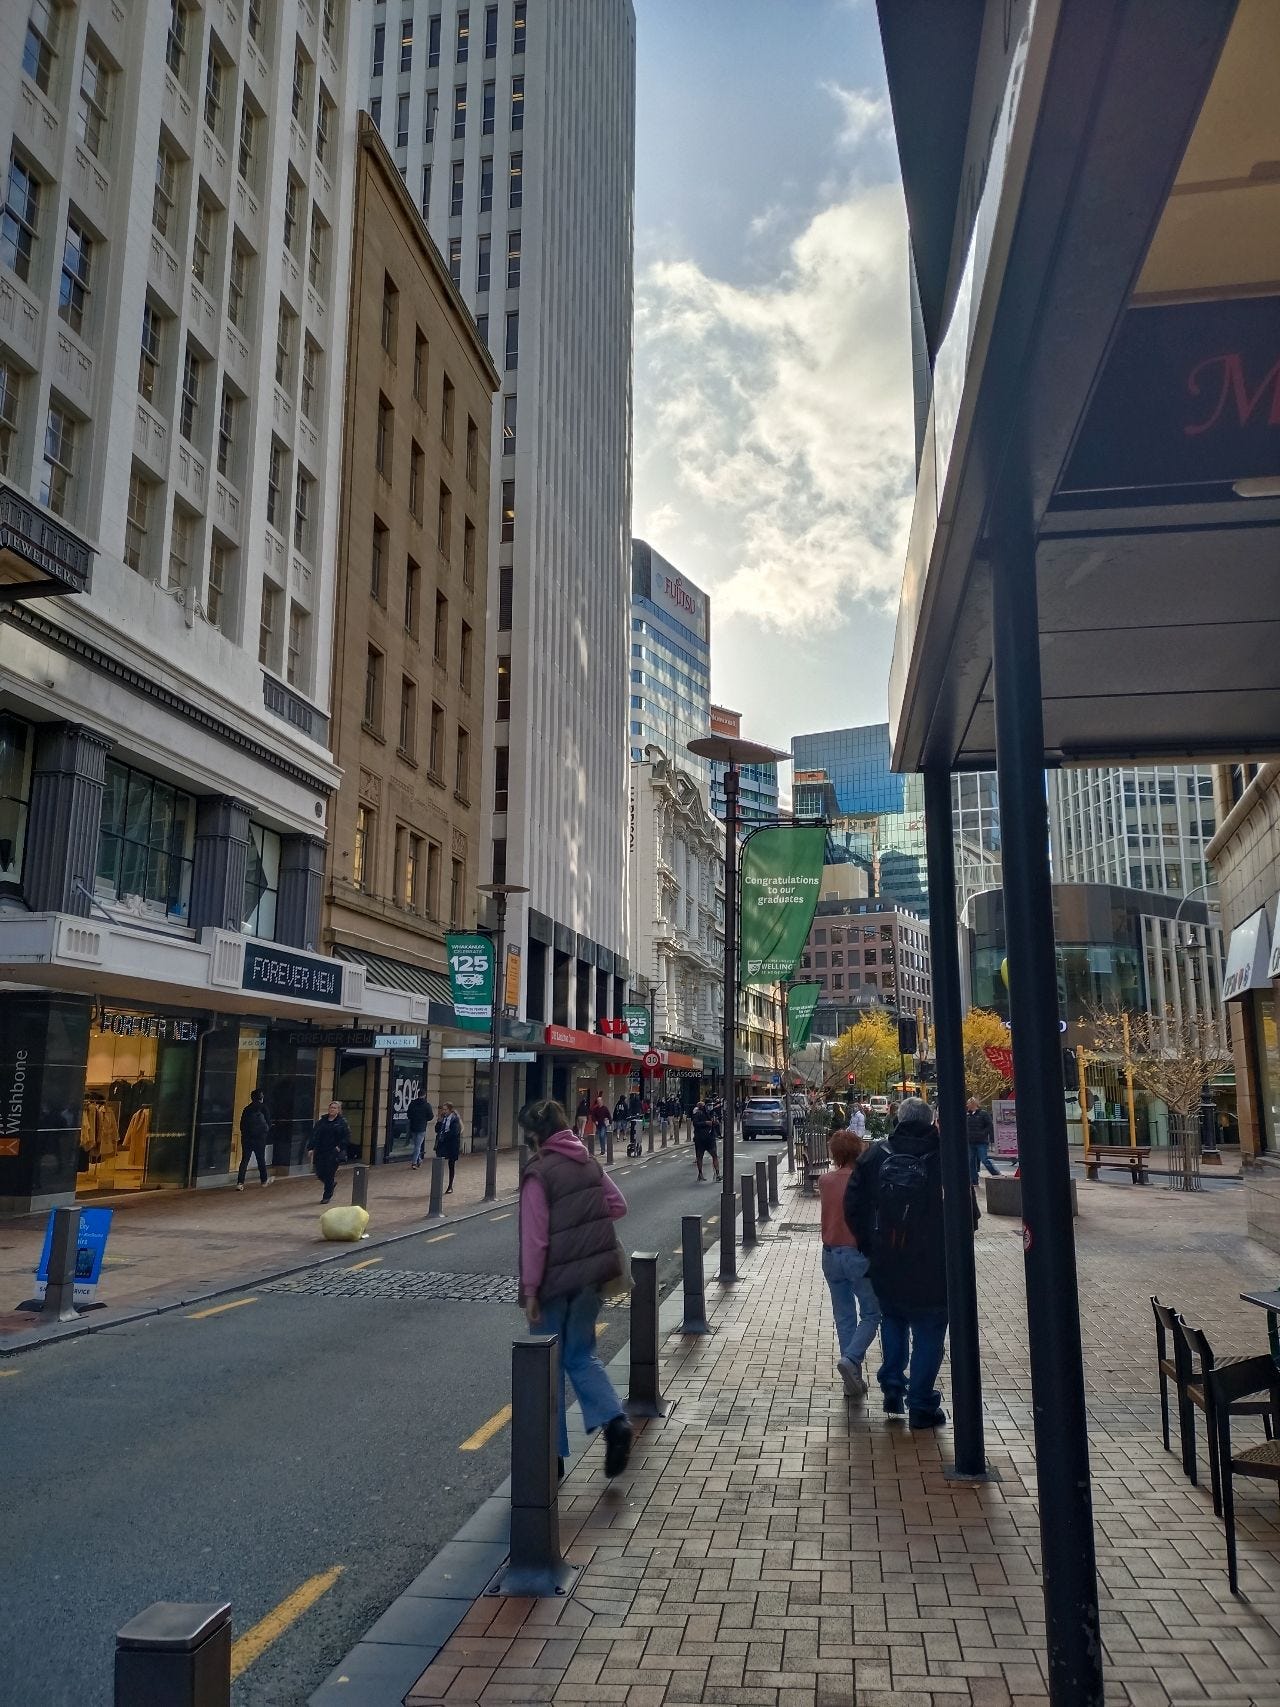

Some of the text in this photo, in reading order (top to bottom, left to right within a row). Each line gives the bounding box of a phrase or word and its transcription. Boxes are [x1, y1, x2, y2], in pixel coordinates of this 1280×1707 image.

[664, 576, 696, 615] FUJITSU
[745, 875, 819, 886] Congratulations
[767, 886, 795, 894] to our
[757, 895, 804, 906] graduates
[450, 956, 488, 972] 125
[252, 956, 335, 994] FOREVER NEW
[625, 1017, 647, 1027] 125
[173, 1020, 198, 1041] NEW
[647, 1056, 658, 1064] 30
[668, 1069, 702, 1078] GLASSONS
[6, 1048, 28, 1135] Wishbone
